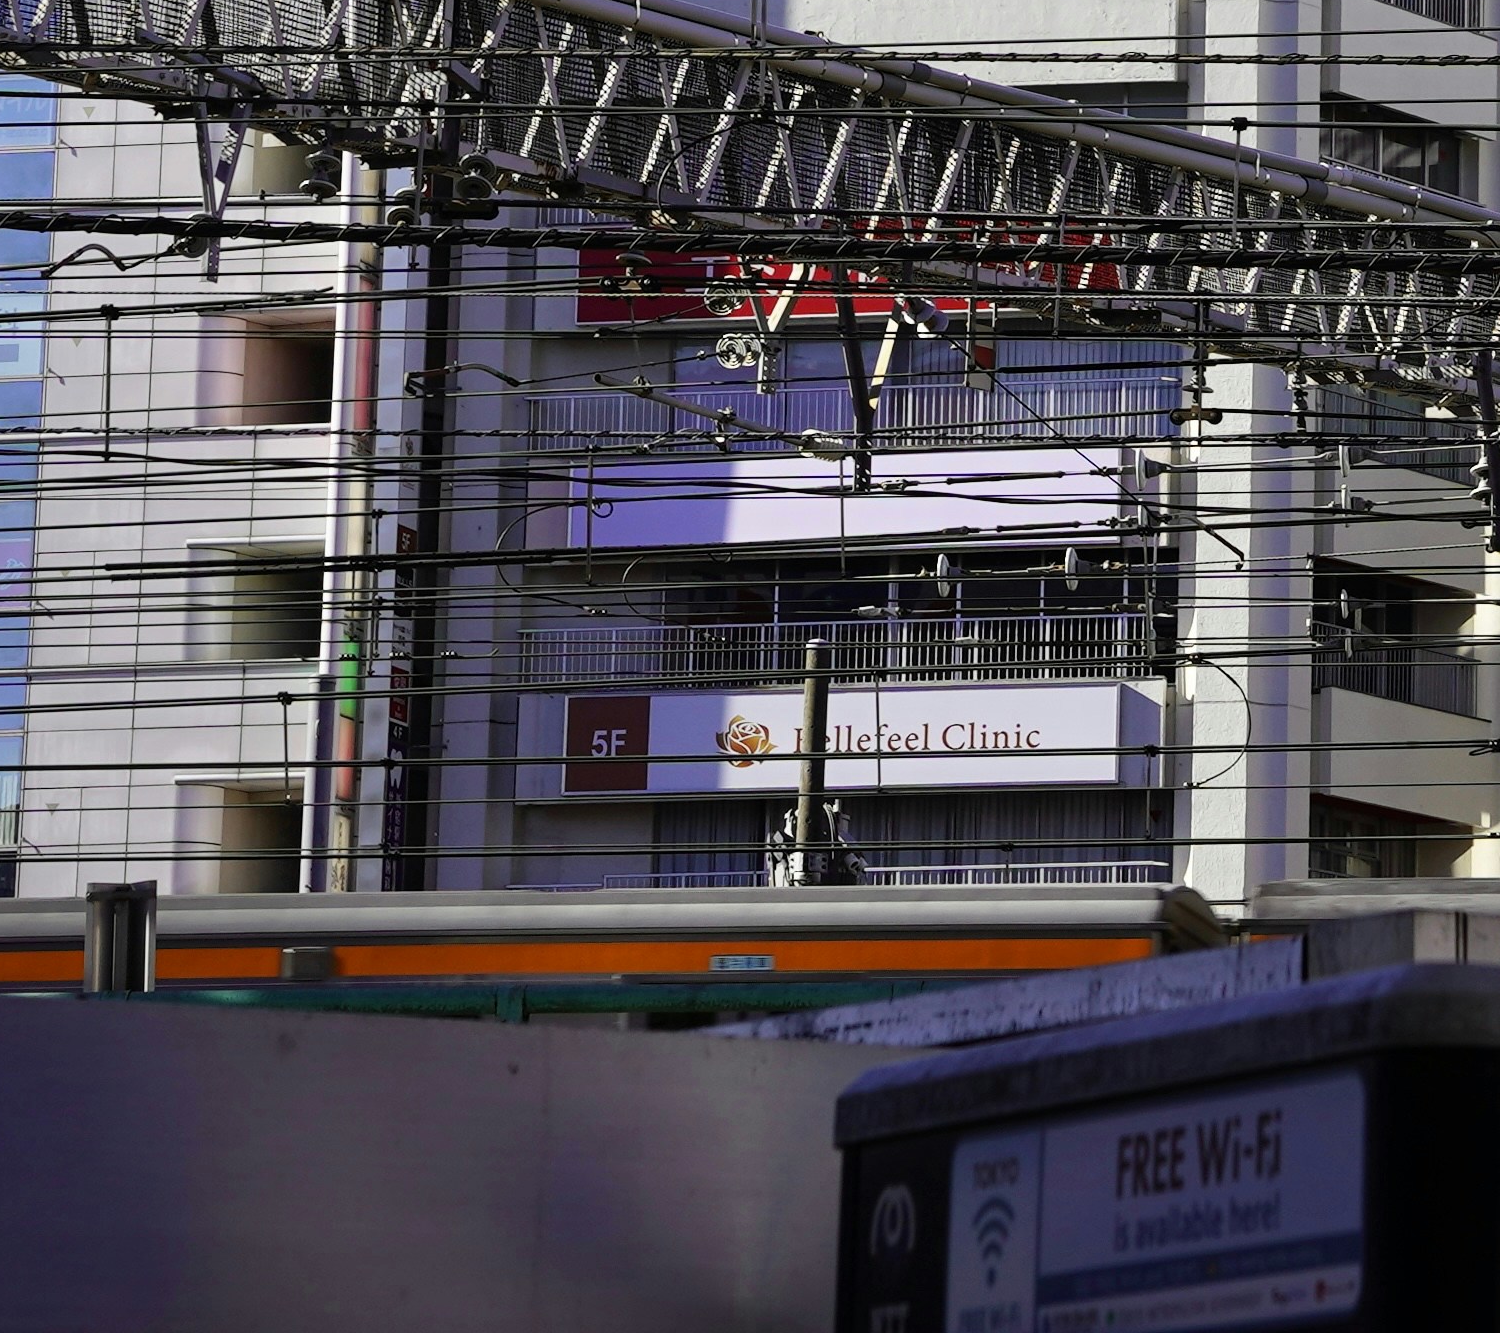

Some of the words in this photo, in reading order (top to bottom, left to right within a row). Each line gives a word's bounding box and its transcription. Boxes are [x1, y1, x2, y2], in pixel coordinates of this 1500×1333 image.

[591, 729, 627, 758] 5F
[941, 720, 1041, 752] Clinic
[1115, 1127, 1186, 1201] FREE
[1196, 1109, 1284, 1183] Wi-Fi
